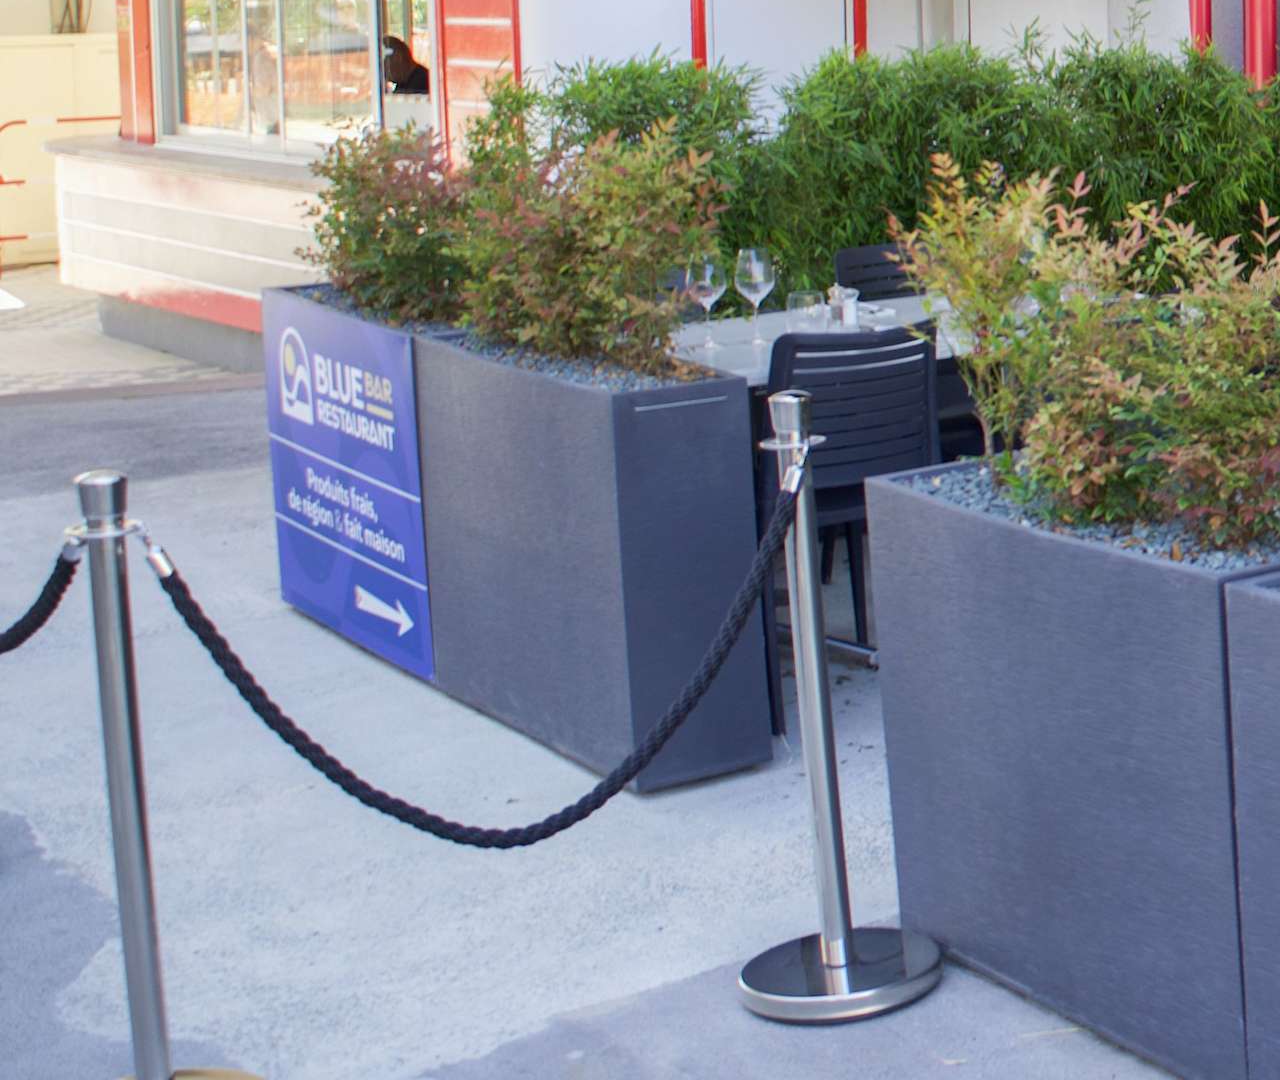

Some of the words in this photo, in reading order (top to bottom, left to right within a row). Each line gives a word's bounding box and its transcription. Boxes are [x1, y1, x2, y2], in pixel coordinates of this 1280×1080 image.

[314, 353, 364, 410] BLUE
[364, 371, 393, 405] BAR
[316, 398, 395, 452] RESTAURANT
[306, 467, 350, 508] Produits
[350, 486, 378, 523] frais,
[288, 487, 301, 512] de
[302, 495, 334, 527] région
[335, 508, 343, 533] &
[343, 513, 363, 543] fait
[363, 528, 405, 564] maison
